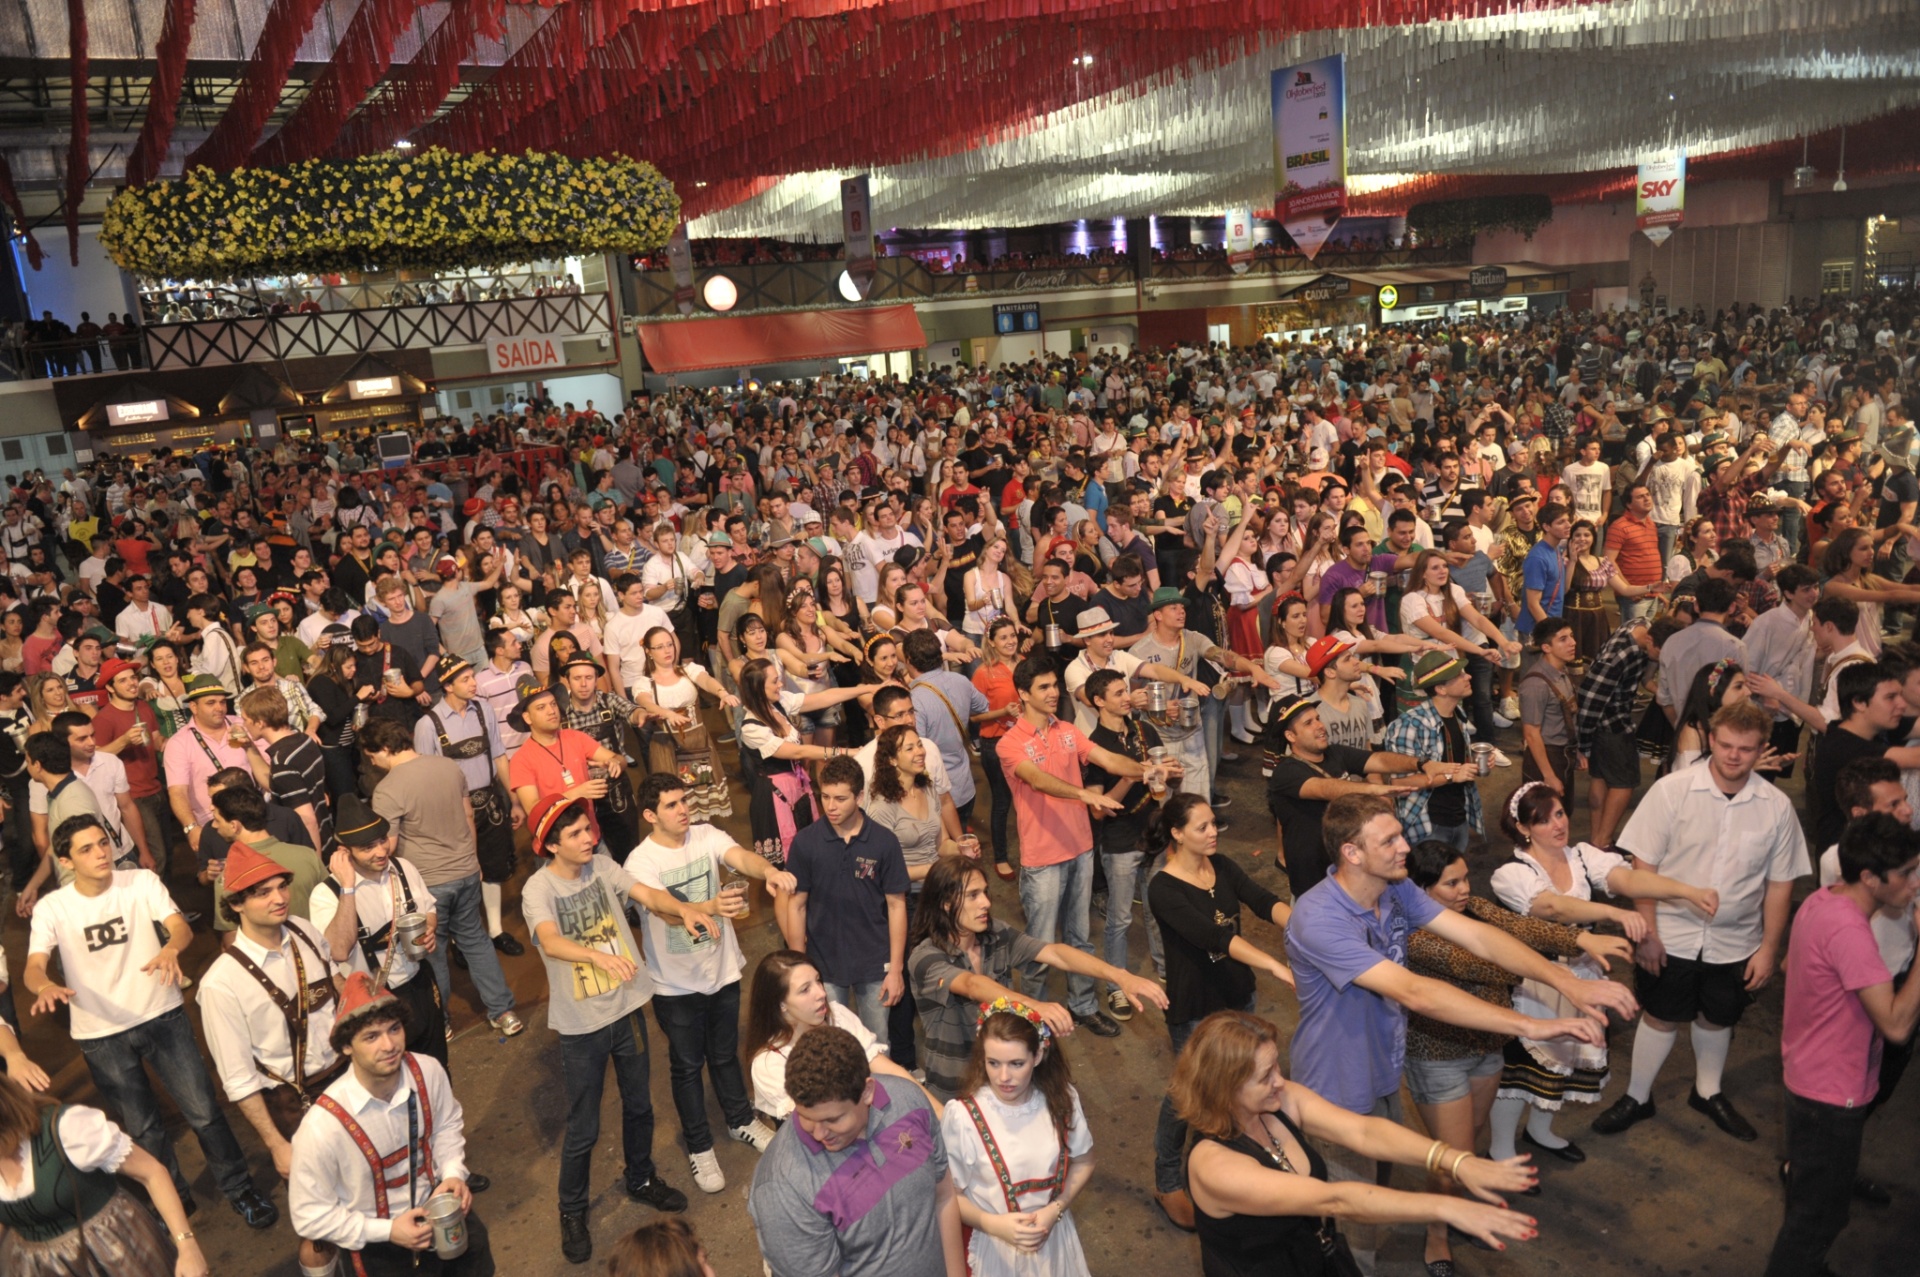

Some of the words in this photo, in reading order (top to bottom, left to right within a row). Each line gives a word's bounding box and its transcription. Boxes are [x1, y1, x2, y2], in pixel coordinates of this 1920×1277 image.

[1286, 149, 1330, 169] BRASIL
[1640, 178, 1678, 199] SKY
[1014, 269, 1067, 290] Camarote
[1471, 271, 1506, 286] Bierland
[1304, 289, 1330, 300] CAIXA
[997, 303, 1037, 312] SANITÁRIOS
[496, 338, 558, 369] SAÍDA
[1325, 718, 1367, 737] RMAN
[83, 916, 128, 953] DC
